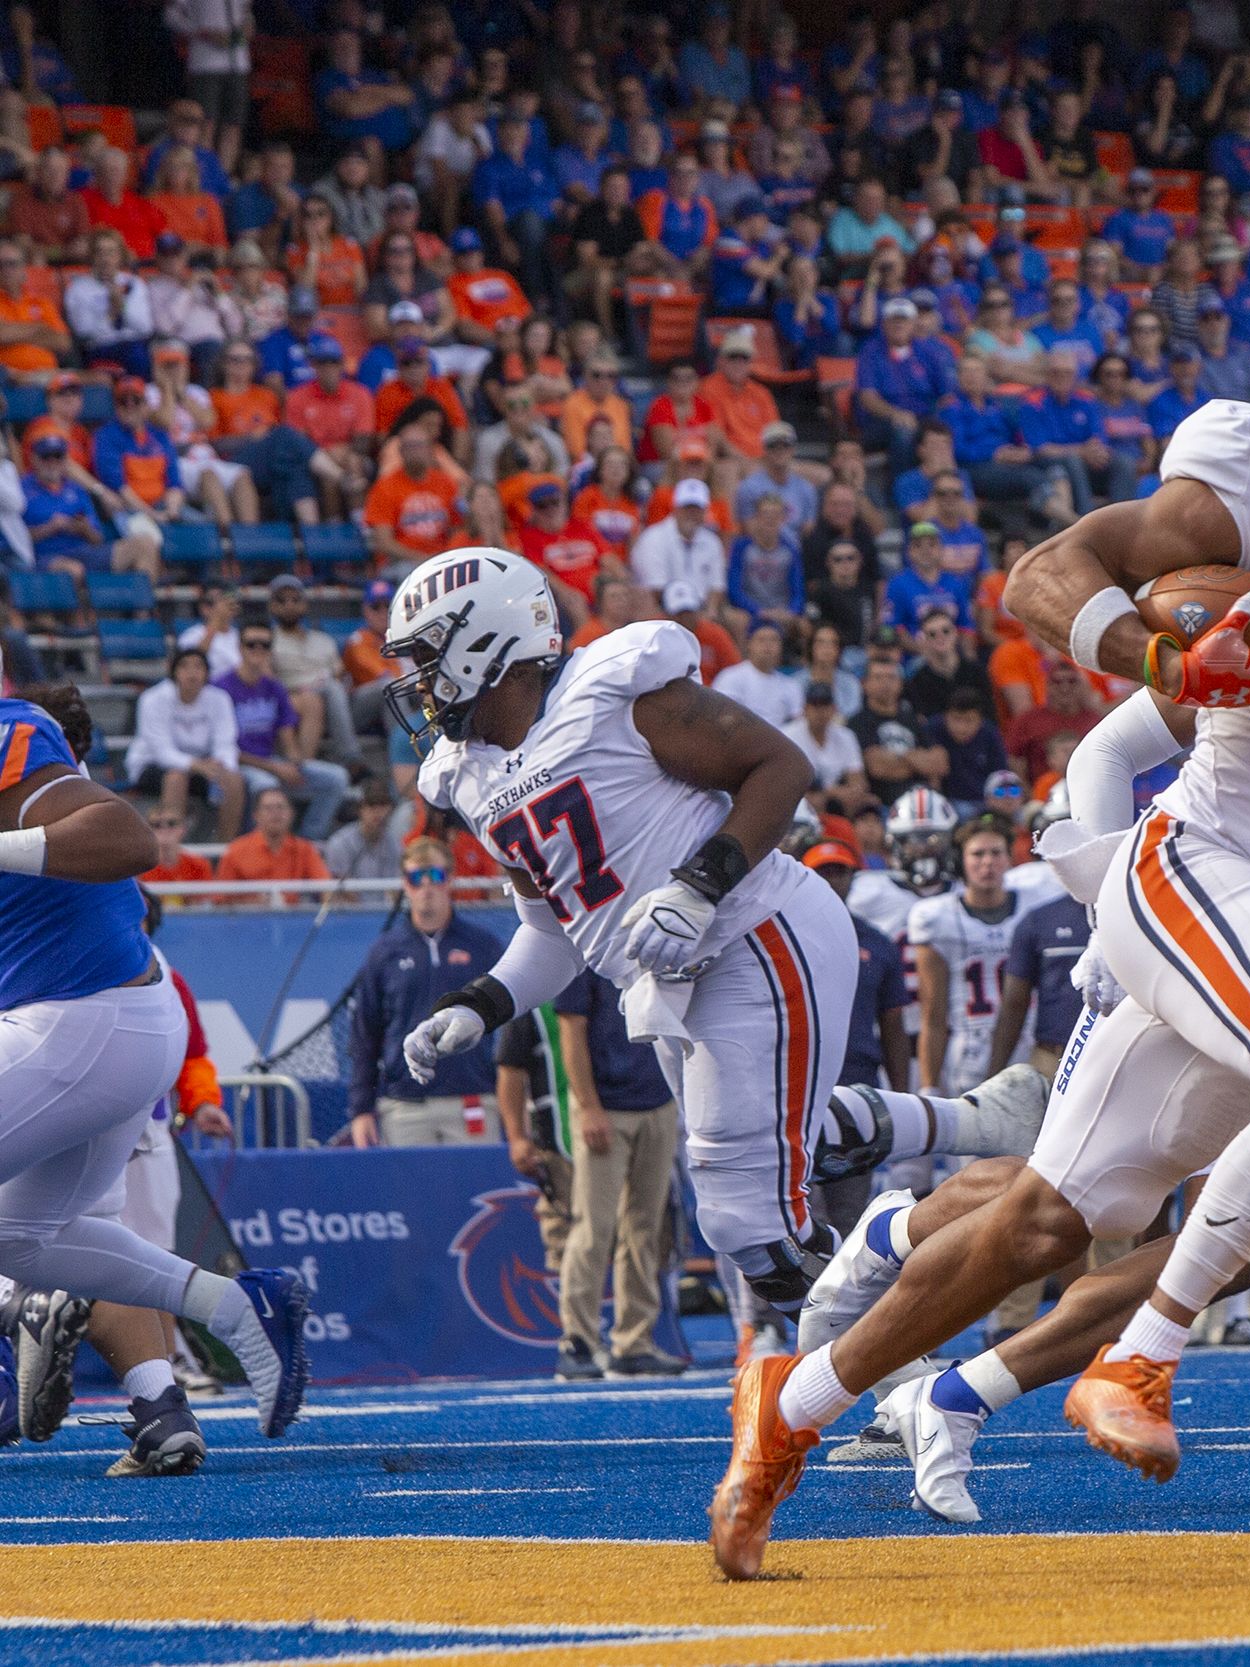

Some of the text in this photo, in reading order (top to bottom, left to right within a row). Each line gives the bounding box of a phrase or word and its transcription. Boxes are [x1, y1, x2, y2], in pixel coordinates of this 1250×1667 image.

[404, 558, 480, 623] UTM
[488, 768, 552, 815] SKYHAWKS
[488, 775, 625, 923] 77
[278, 1207, 410, 1244] Stores
